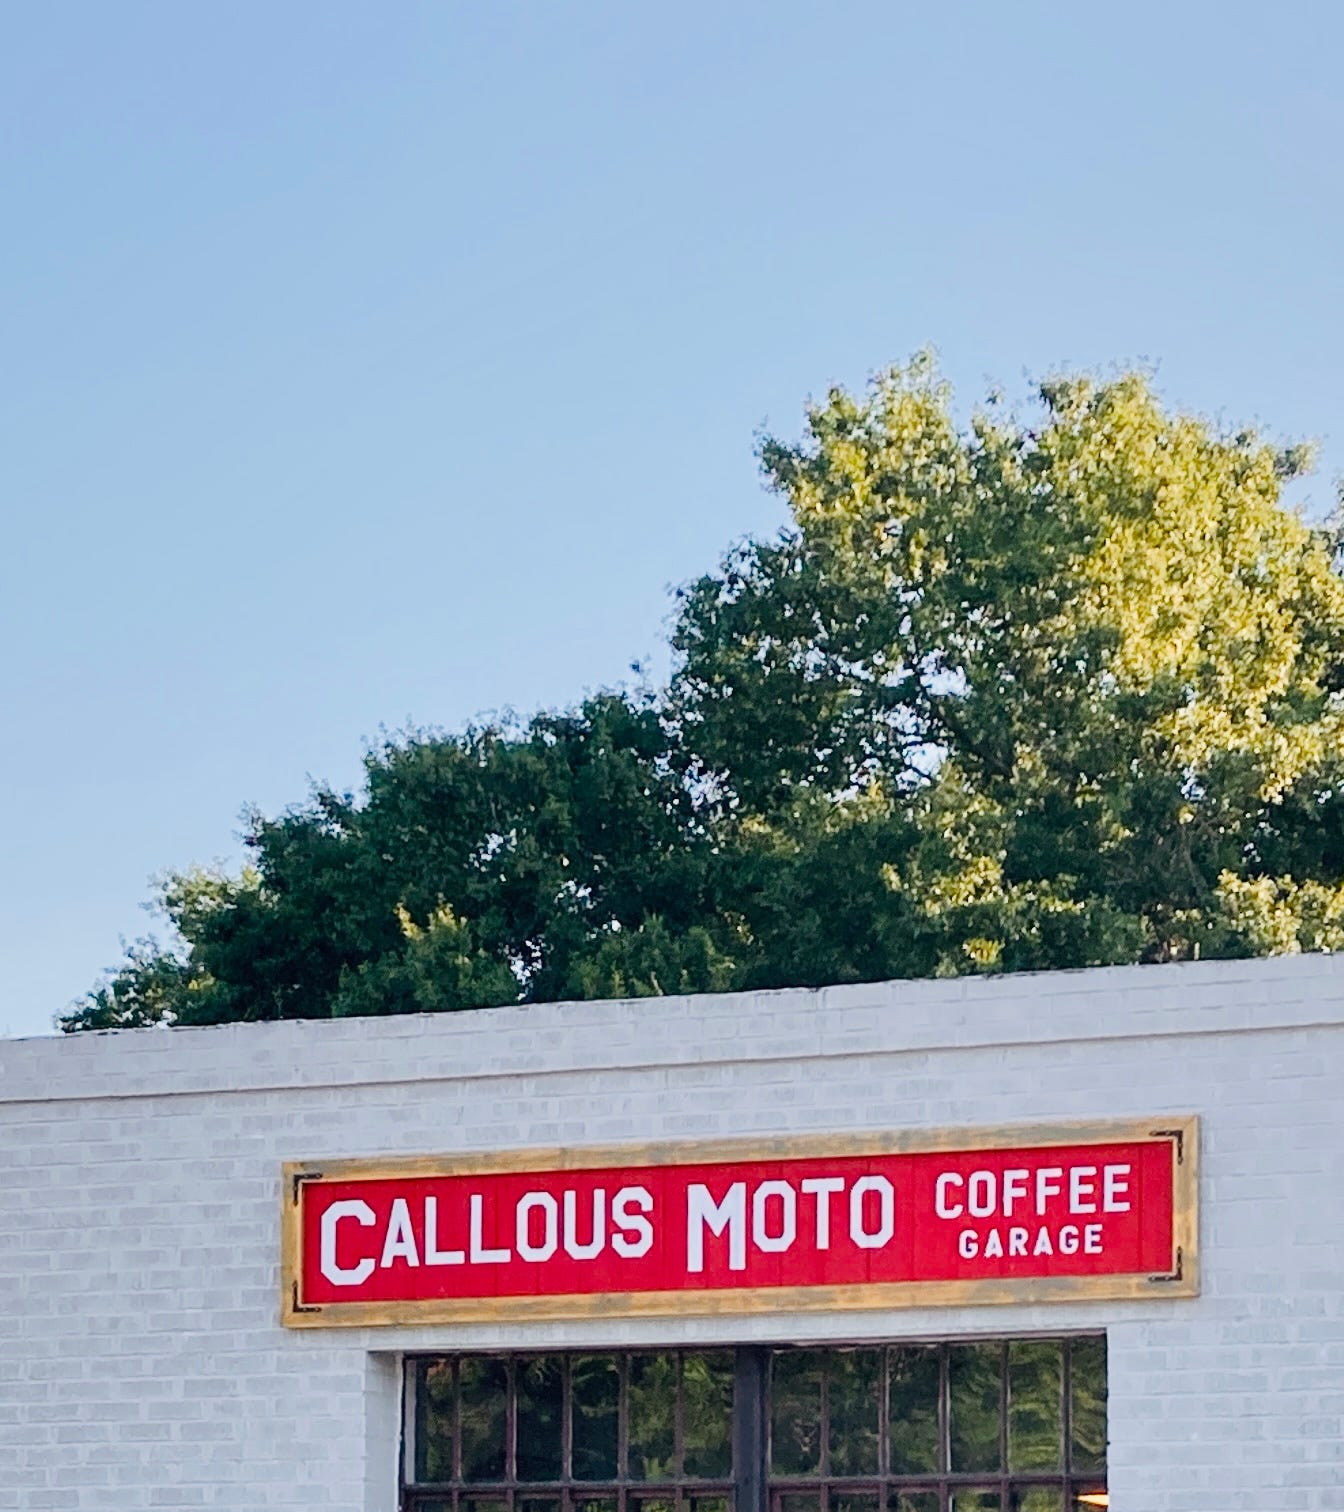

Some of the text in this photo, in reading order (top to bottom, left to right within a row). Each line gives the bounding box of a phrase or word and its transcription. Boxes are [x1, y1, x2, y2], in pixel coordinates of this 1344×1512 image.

[935, 1164, 1132, 1219] COFFEE
[319, 1175, 895, 1286] CALLOUS MOTO
[959, 1224, 1104, 1259] GARAGE
